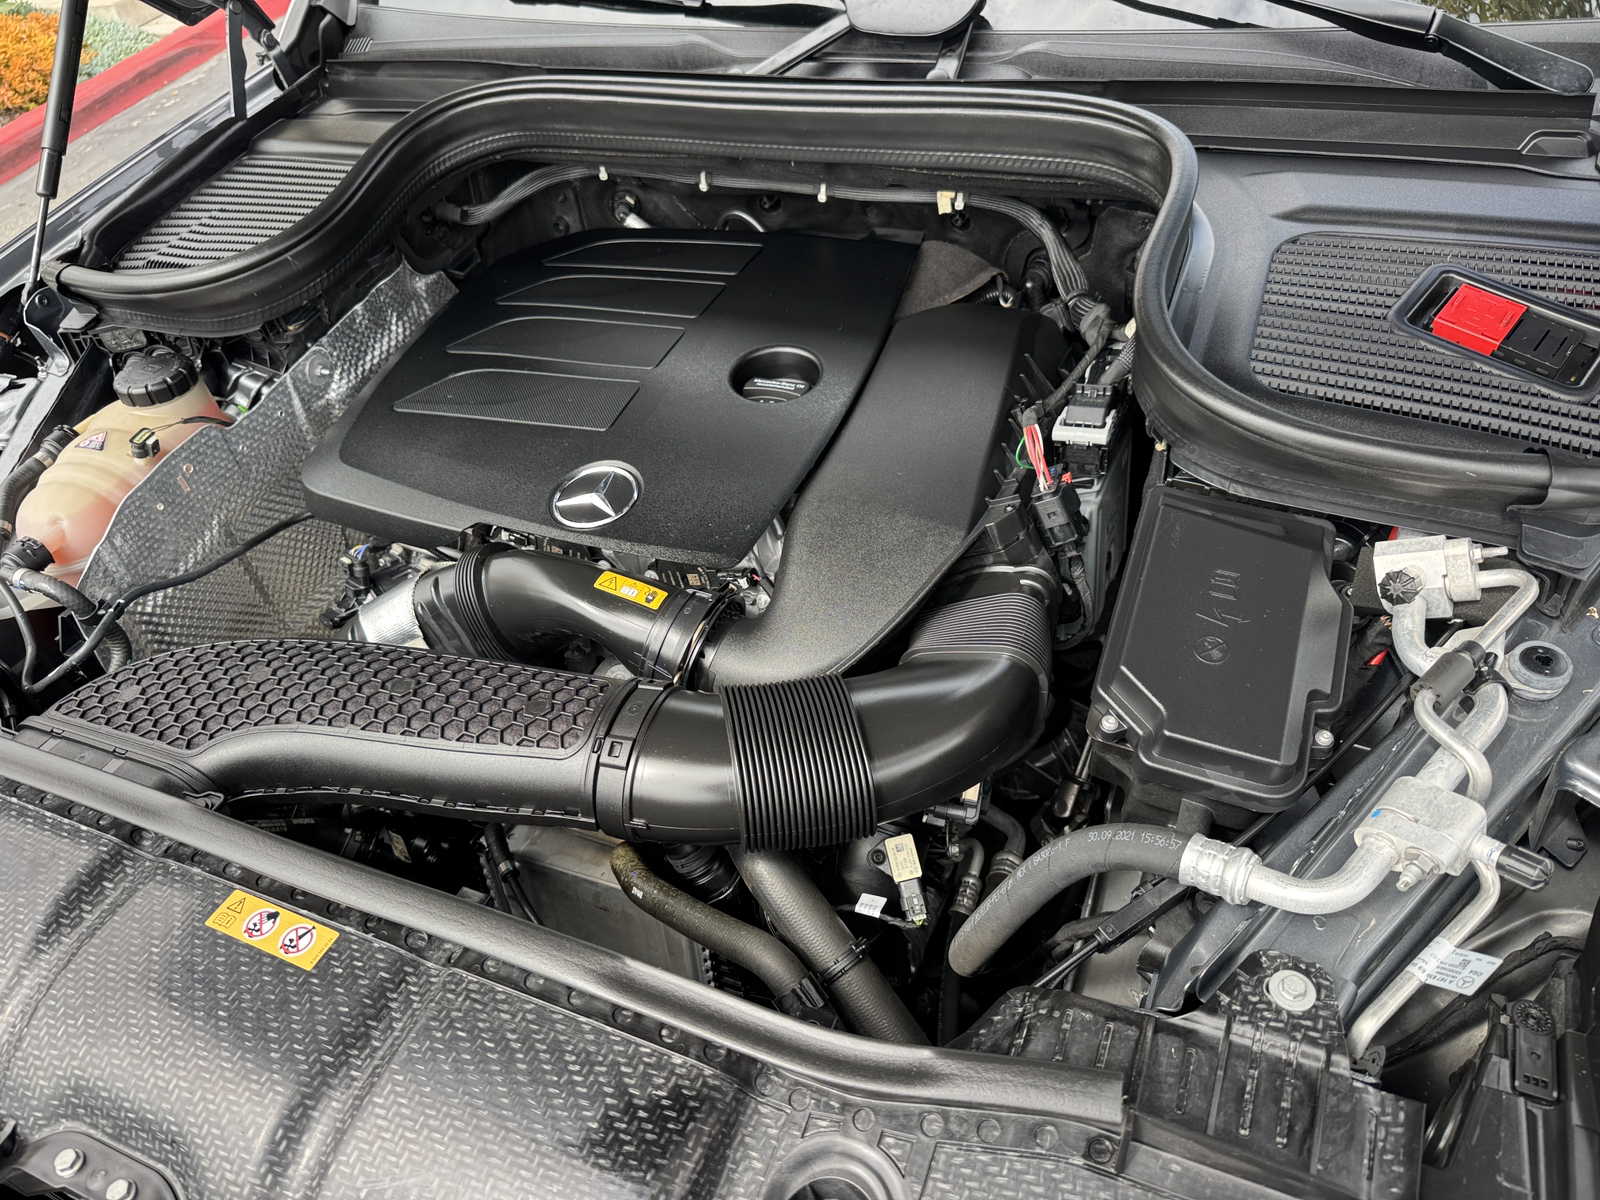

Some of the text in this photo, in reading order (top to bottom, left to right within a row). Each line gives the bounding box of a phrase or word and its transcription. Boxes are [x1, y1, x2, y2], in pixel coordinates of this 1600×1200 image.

[753, 378, 796, 387] Mercedes-Benz
[755, 382, 796, 391] recommended
[1087, 830, 1136, 843] 30.09.2021
[1140, 831, 1183, 851] 15:56:57
